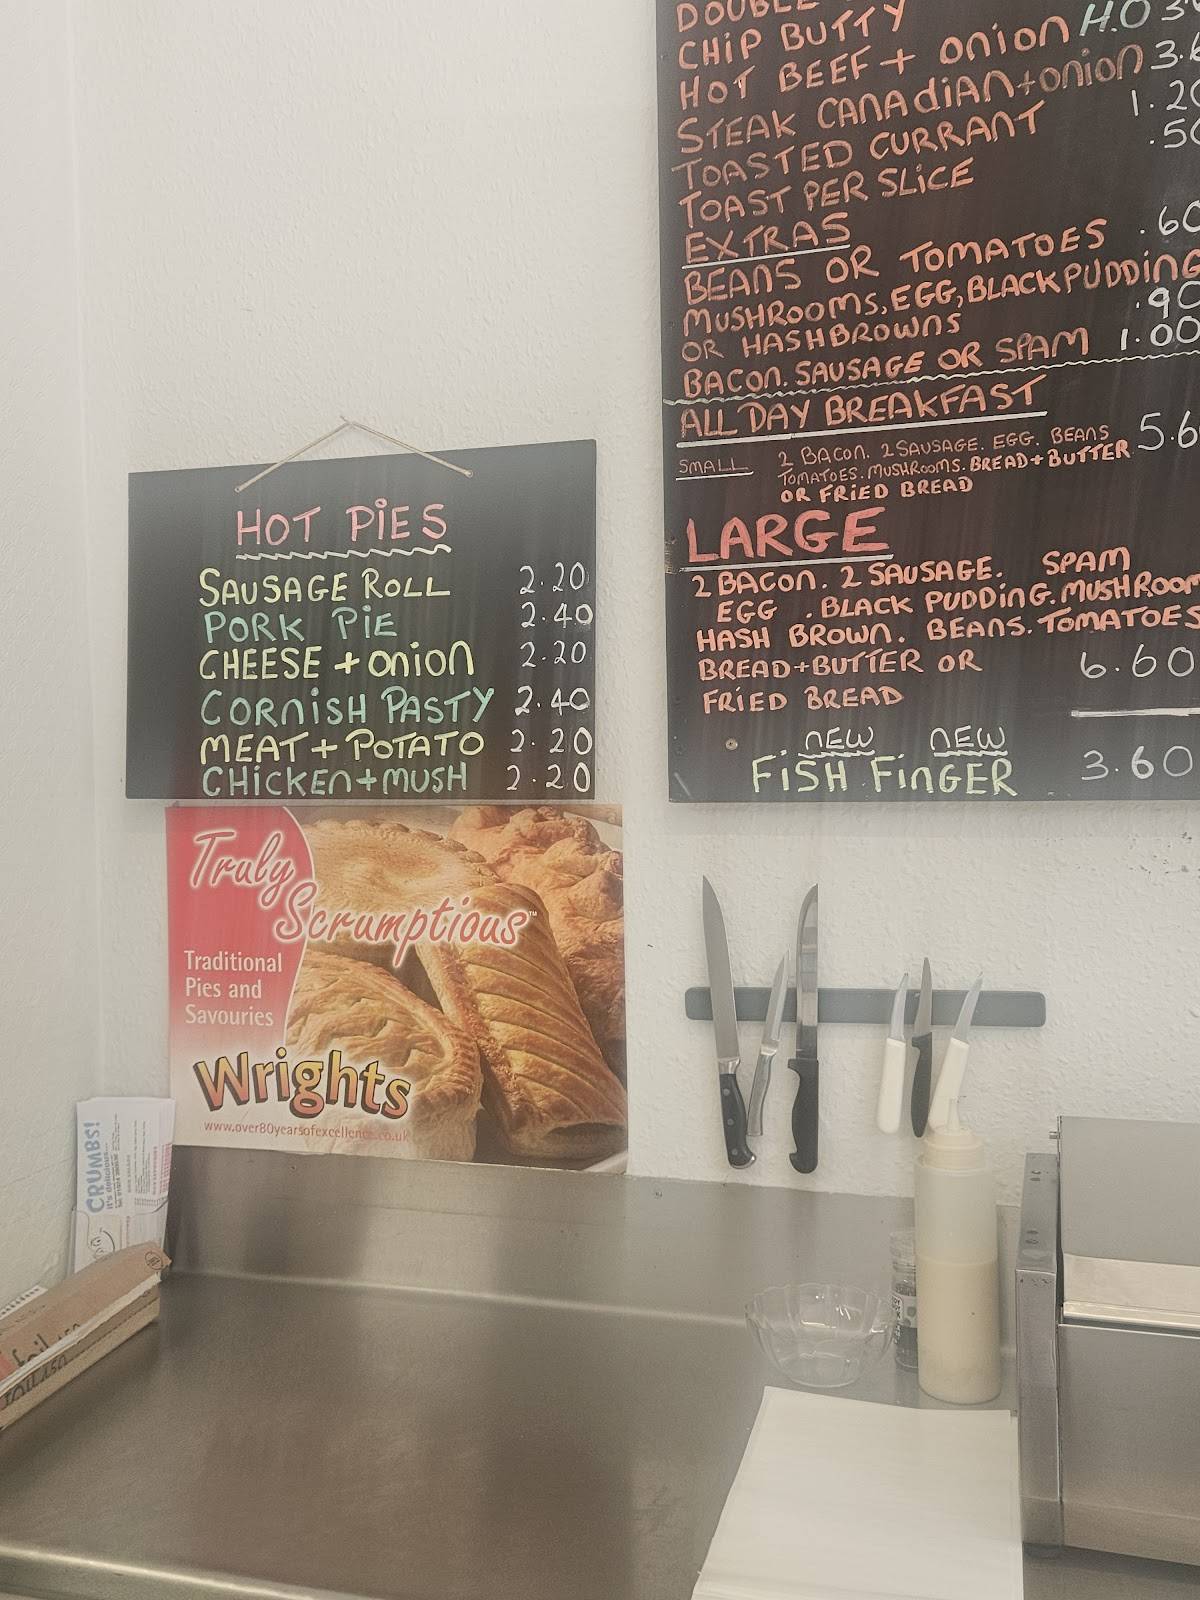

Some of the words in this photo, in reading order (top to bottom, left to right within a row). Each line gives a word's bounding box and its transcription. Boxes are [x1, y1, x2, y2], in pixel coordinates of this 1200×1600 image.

[781, 0, 906, 51] BUTTY
[680, 65, 755, 110] HOT
[779, 45, 871, 92] BEEF
[880, 48, 916, 75] +
[671, 140, 853, 190] TOASTED
[870, 100, 1046, 160] CURRANT
[677, 110, 796, 153] STEAK
[678, 185, 792, 229] TOAST
[803, 170, 869, 212] PER
[685, 211, 850, 264] EXTRAS
[826, 245, 880, 283] OR
[900, 217, 1107, 272] TOMATOES
[967, 269, 1061, 303] BLACK
[682, 339, 724, 362] OR
[795, 351, 925, 386] SAUSAGE
[937, 341, 983, 370] OR
[996, 327, 1089, 363] SPAM
[1121, 315, 1200, 351] 1.00
[681, 408, 738, 438] ALL
[737, 400, 811, 433] DAY
[826, 374, 1047, 426] BREAKFAST
[679, 458, 749, 475] SMALL
[778, 451, 794, 467] 2
[881, 443, 895, 458] 2
[1138, 410, 1200, 451] 5.6
[781, 487, 811, 503] OR
[901, 476, 974, 498] BREAD
[237, 506, 321, 546] HOT
[687, 506, 890, 563] LARGE
[199, 567, 348, 608] SAUSAGE
[361, 567, 450, 599] ROLL
[519, 561, 587, 595] 2.20
[692, 575, 712, 598] 2
[841, 565, 862, 588] 2
[1042, 547, 1130, 576] SPAM
[204, 610, 304, 644] PORK
[521, 601, 593, 628] 2.40
[697, 627, 771, 652] HASH
[1037, 605, 1200, 634] TOMATOES
[199, 645, 322, 680] CHEESE
[334, 651, 360, 675] +
[520, 640, 587, 668] 2.20
[937, 648, 983, 672] OR
[1080, 643, 1195, 678] 6.60
[381, 685, 494, 724] PASTY
[515, 685, 591, 716] 2.40
[804, 685, 905, 710] BREAD
[200, 731, 309, 765] MEAT
[311, 738, 338, 759] +
[345, 728, 485, 761] POTATO
[510, 727, 593, 755] 2.20
[1082, 745, 1194, 780] 3.60
[506, 762, 591, 793] 2.20
[190, 829, 295, 910] Truly
[273, 880, 530, 968] Scrumptious
[184, 950, 283, 973] Traditional
[185, 977, 221, 999] Pies
[228, 979, 262, 1000] and
[185, 1004, 274, 1027] Savouries
[193, 1047, 411, 1119] Wrights
[83, 1121, 105, 1214] CRUMBS!
